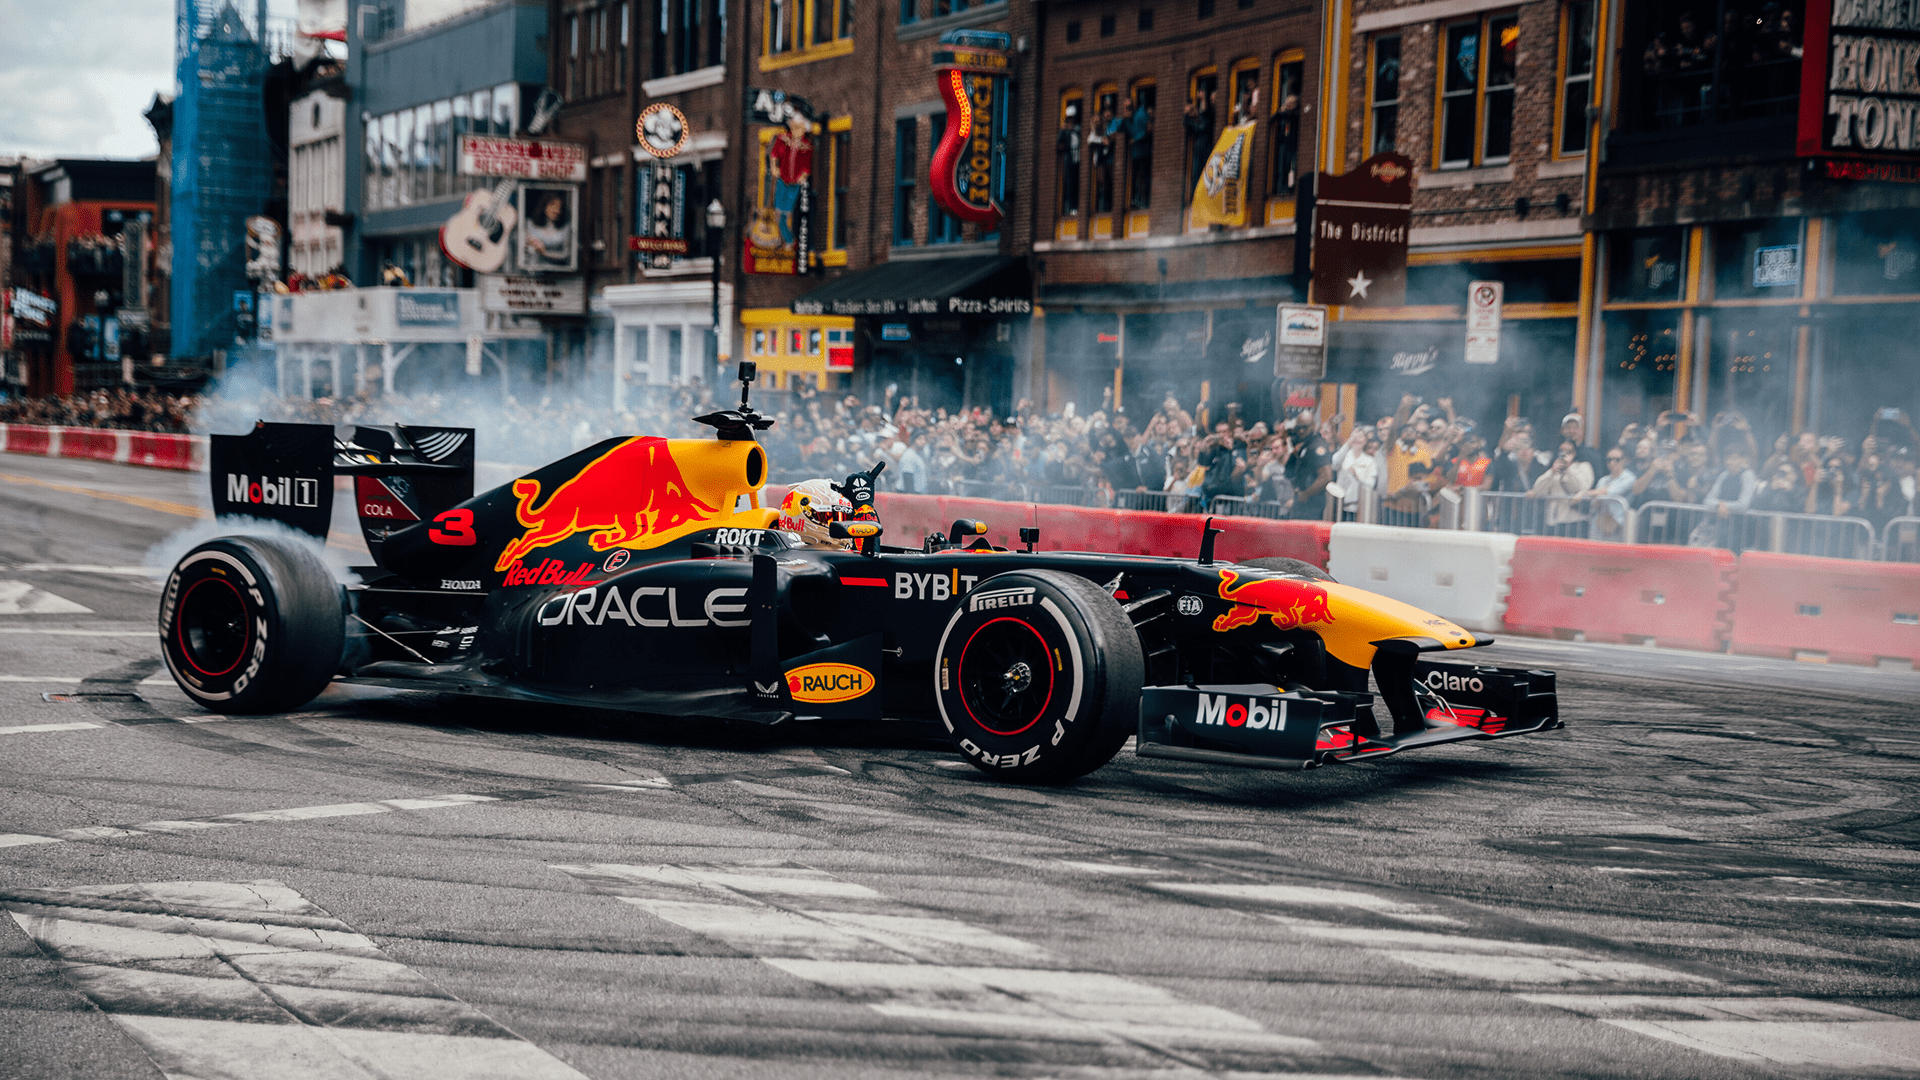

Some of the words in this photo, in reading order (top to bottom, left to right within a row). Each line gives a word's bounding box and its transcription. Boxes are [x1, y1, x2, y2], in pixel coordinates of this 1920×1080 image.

[968, 75, 993, 203] MUSHROOM
[653, 166, 672, 237] HANK
[1320, 220, 1343, 239] The
[1351, 221, 1404, 243] District
[227, 473, 291, 507] Mobil
[364, 503, 394, 516] COLA
[787, 516, 805, 532] Bull
[428, 508, 478, 547] 3
[714, 527, 766, 547] ROKT
[440, 579, 481, 590] HONDA
[502, 559, 541, 587] Red
[538, 558, 604, 587] Bull
[895, 568, 978, 601] BYBIT
[160, 571, 181, 640] PIRELLI
[248, 587, 265, 607] P
[537, 585, 752, 628] ORACLE
[969, 586, 1036, 612] PIRELLI
[1178, 598, 1202, 613] FIA
[233, 615, 267, 695] ZERO
[803, 673, 862, 692] RAUCH
[1427, 670, 1484, 693] Claro
[1195, 692, 1288, 731] Mobil
[1051, 718, 1066, 747] P
[959, 737, 1042, 769] ZERO
